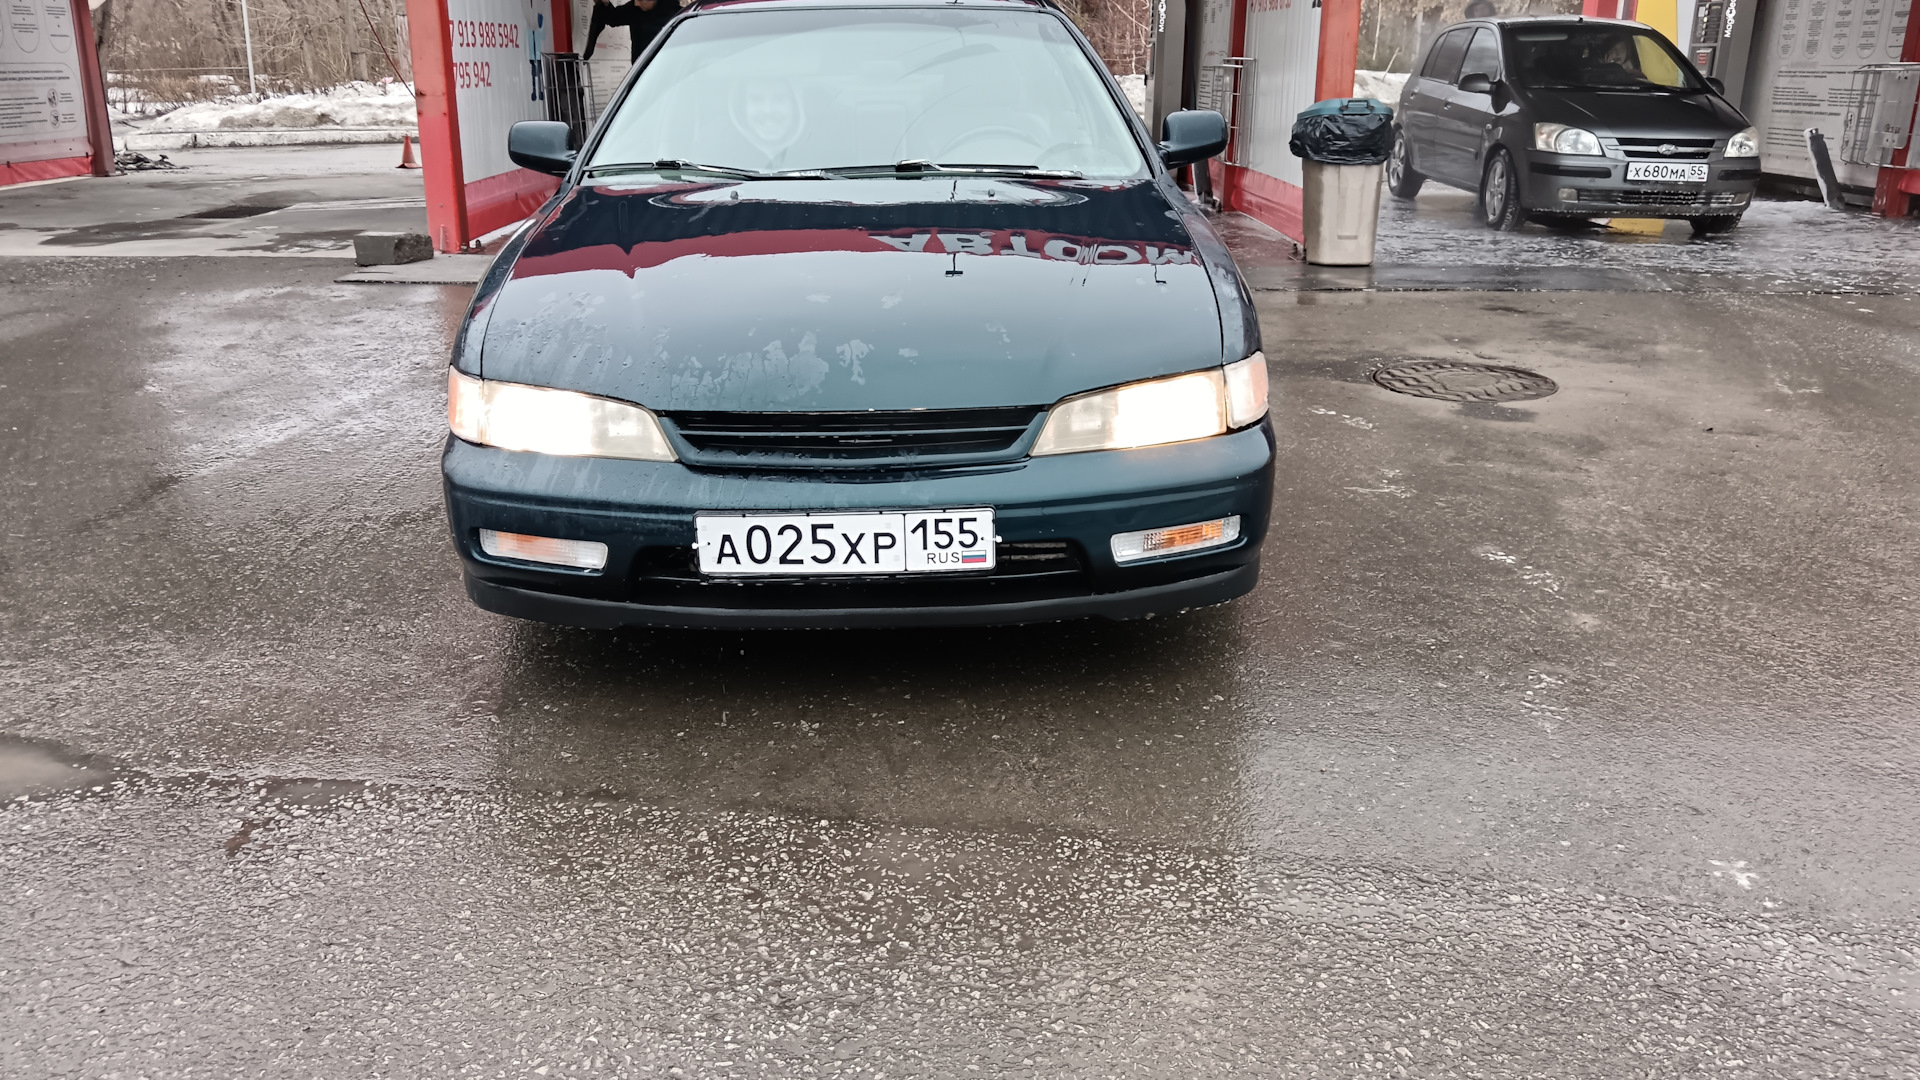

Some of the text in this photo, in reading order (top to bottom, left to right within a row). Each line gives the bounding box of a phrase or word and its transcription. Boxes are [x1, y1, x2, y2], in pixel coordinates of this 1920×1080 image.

[458, 20, 477, 48] 913
[478, 21, 497, 48] 988
[498, 23, 520, 48] 5942
[473, 61, 492, 88] 942
[1633, 165, 1704, 179] Х680МА 55
[715, 517, 979, 566] А025ХР 155
[926, 551, 960, 564] RUS
